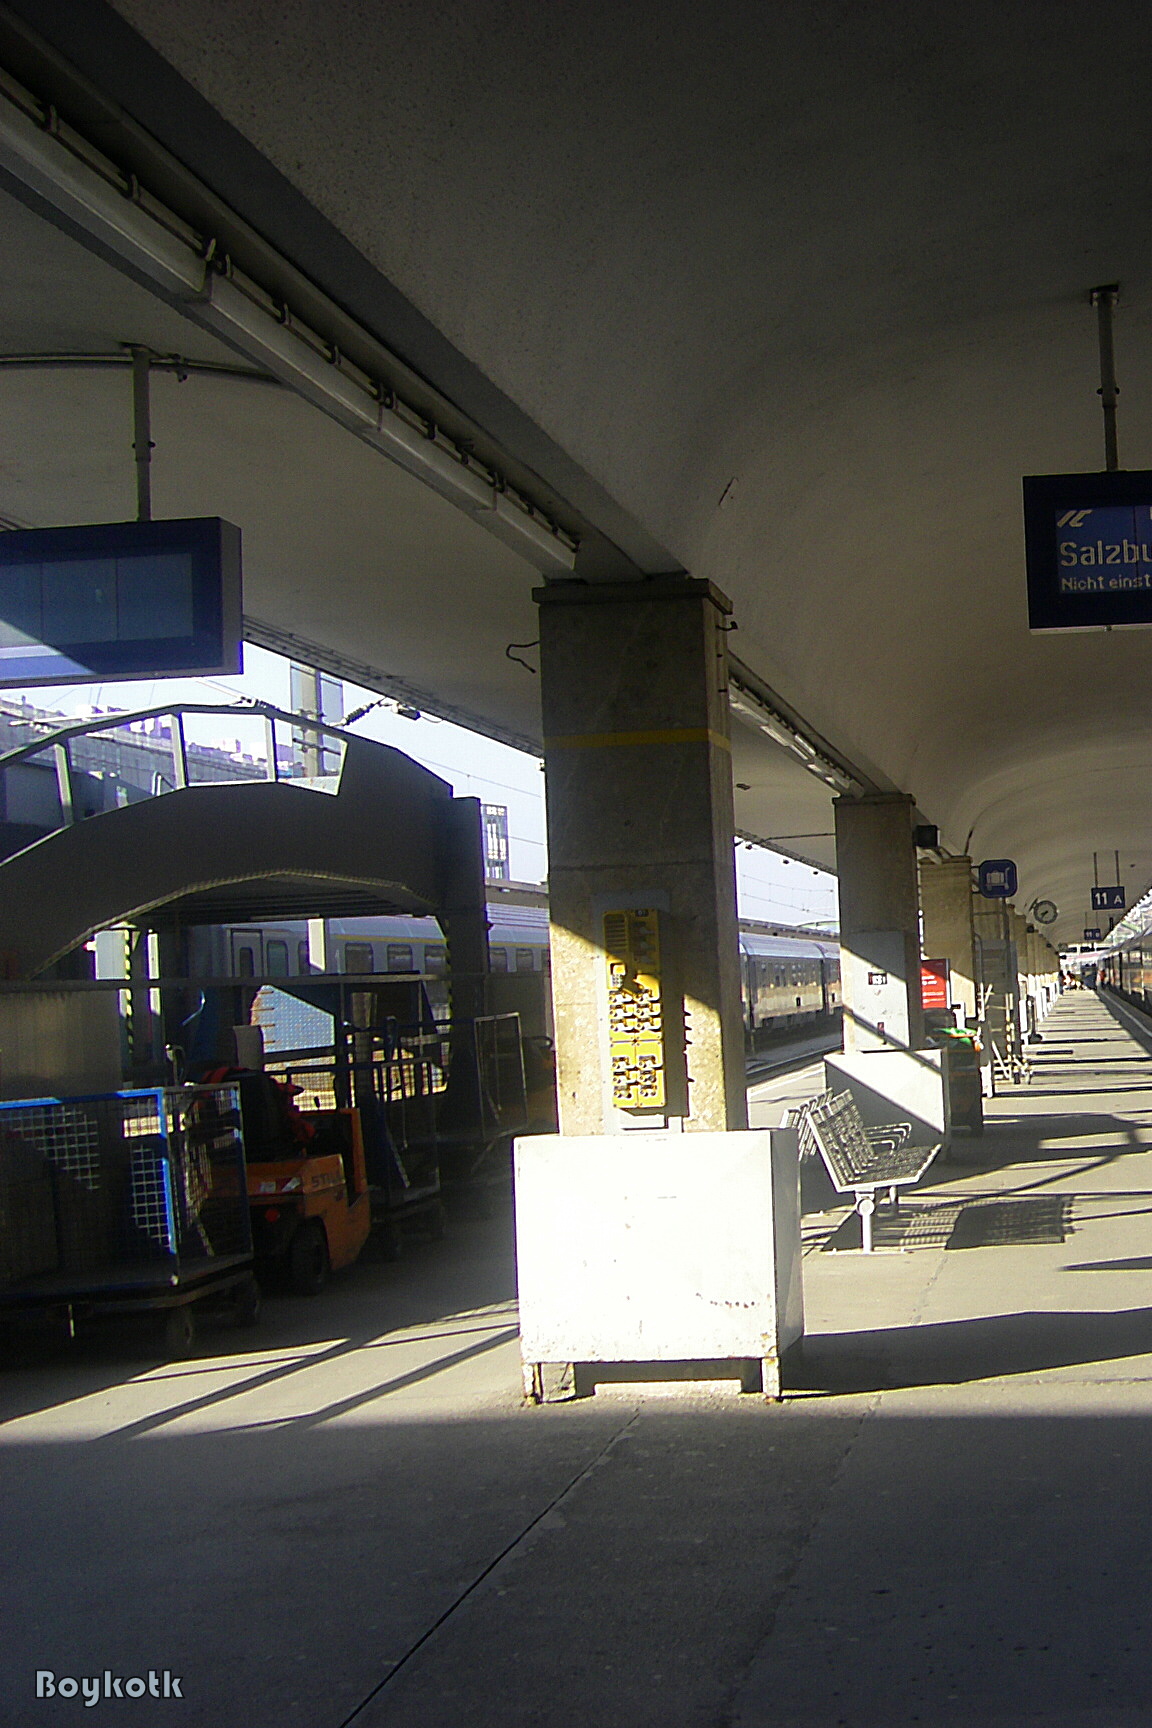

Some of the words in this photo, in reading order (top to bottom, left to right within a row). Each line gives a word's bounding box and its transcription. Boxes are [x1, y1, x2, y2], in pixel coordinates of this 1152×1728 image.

[1060, 575, 1105, 592] Nicht
[1095, 892, 1108, 905] 11
[1114, 895, 1123, 904] A
